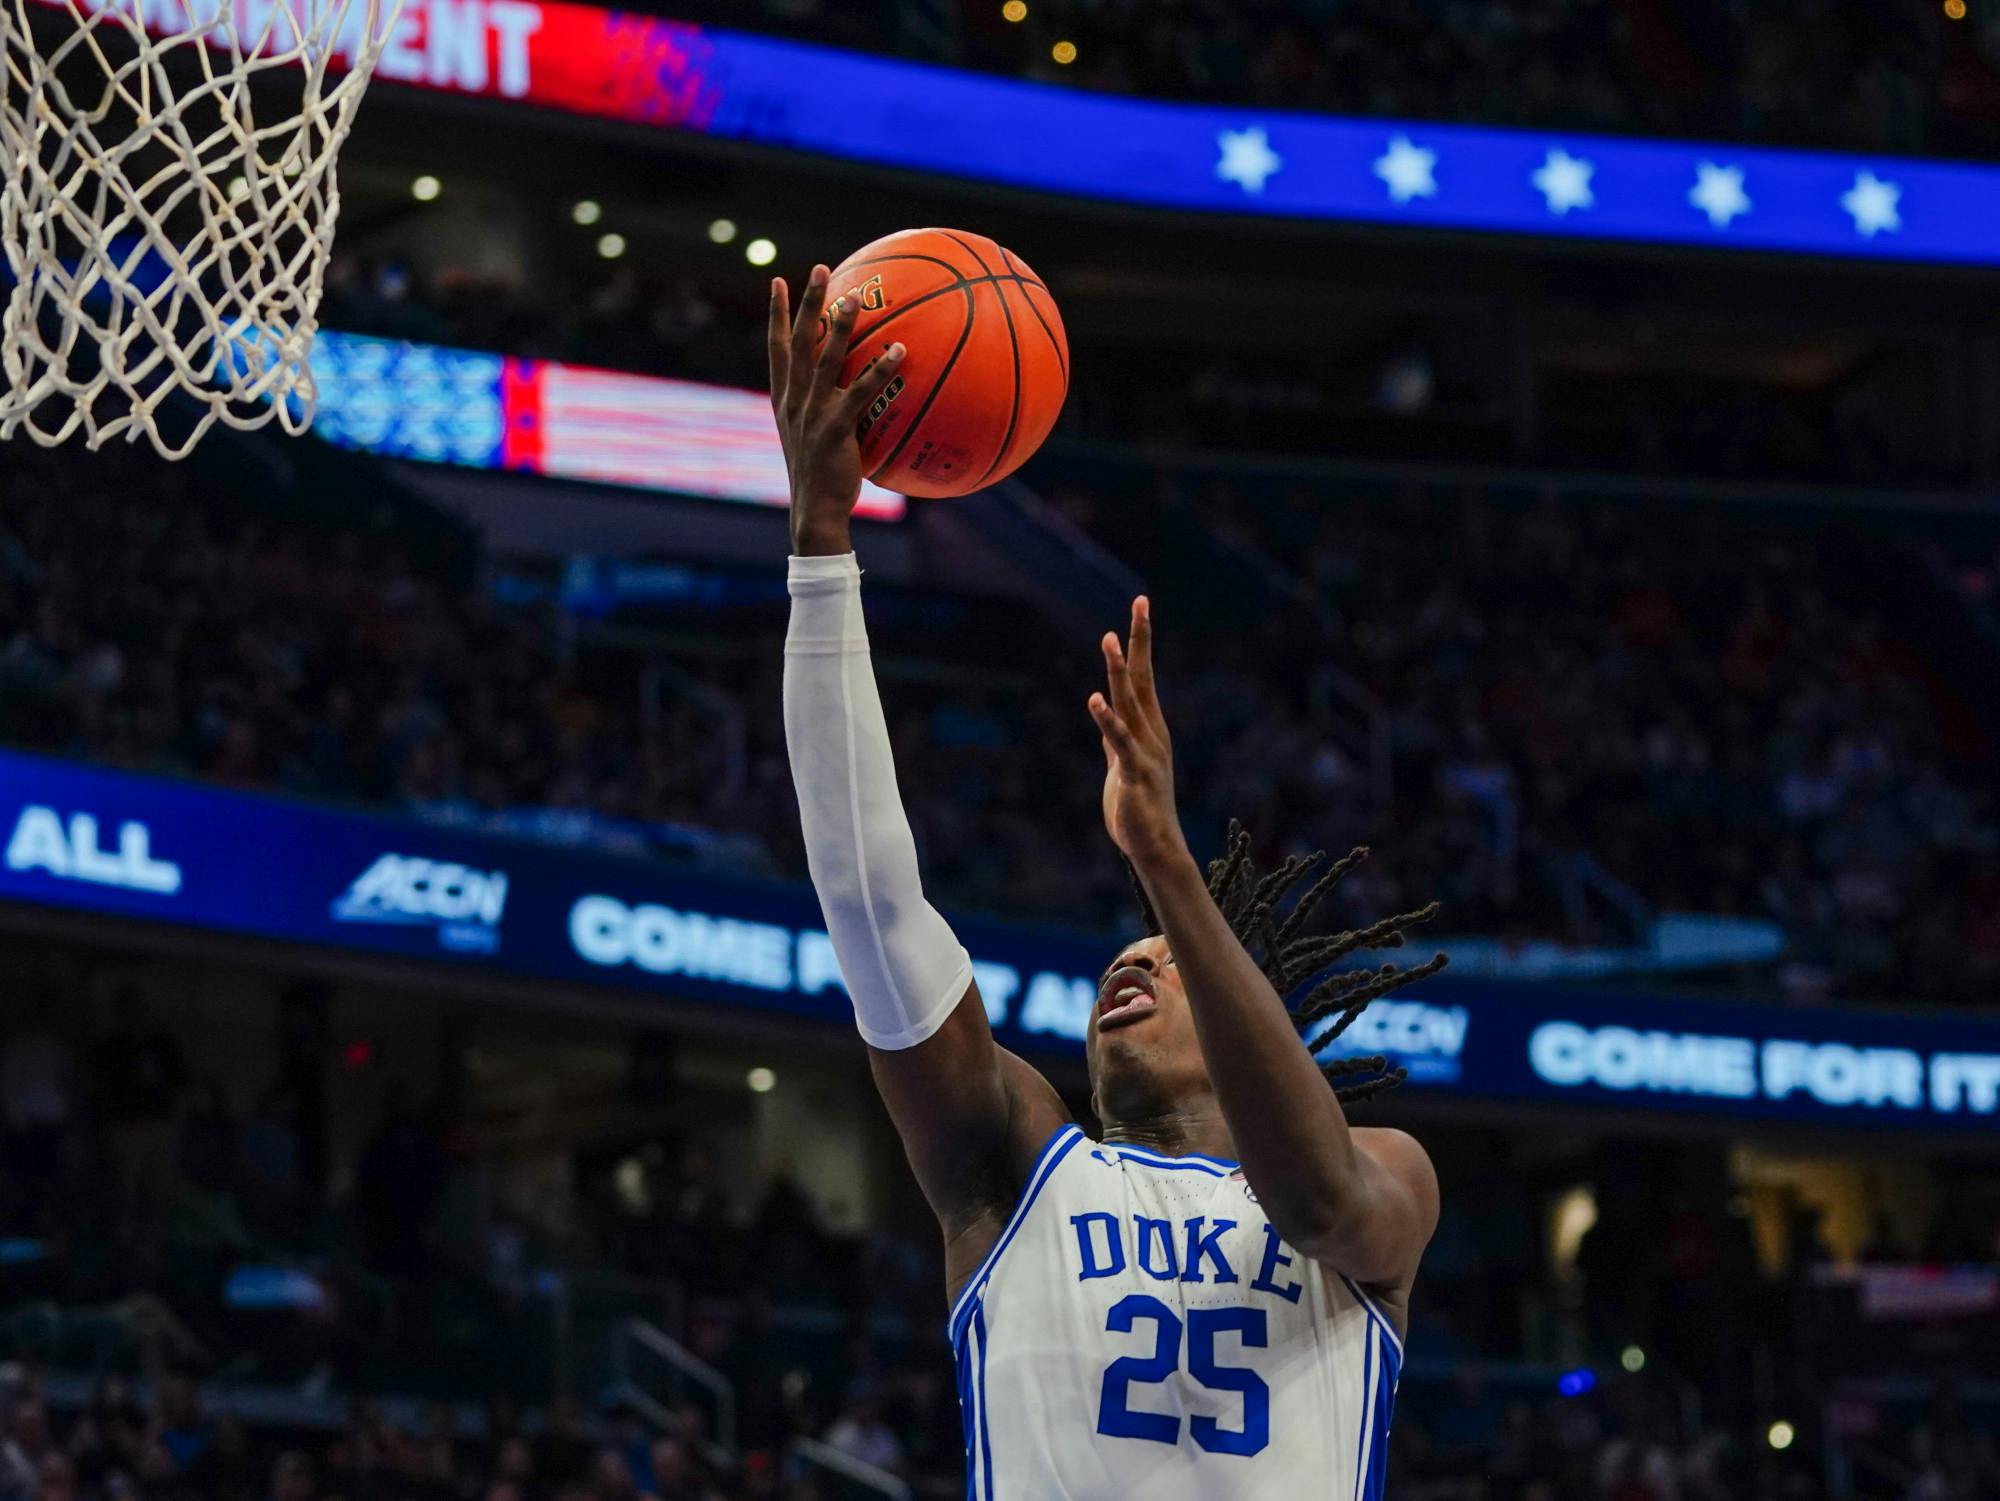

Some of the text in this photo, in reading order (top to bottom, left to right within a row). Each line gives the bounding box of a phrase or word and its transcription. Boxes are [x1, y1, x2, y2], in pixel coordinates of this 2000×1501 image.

[5, 806, 182, 894] ALL
[345, 852, 509, 926] ACCN
[568, 895, 793, 991] COME
[1020, 970, 1097, 1041] AL
[1529, 1021, 2000, 1115] COME FOR IT
[1070, 1211, 1303, 1304] DUKE
[1097, 1294, 1270, 1458] 25
